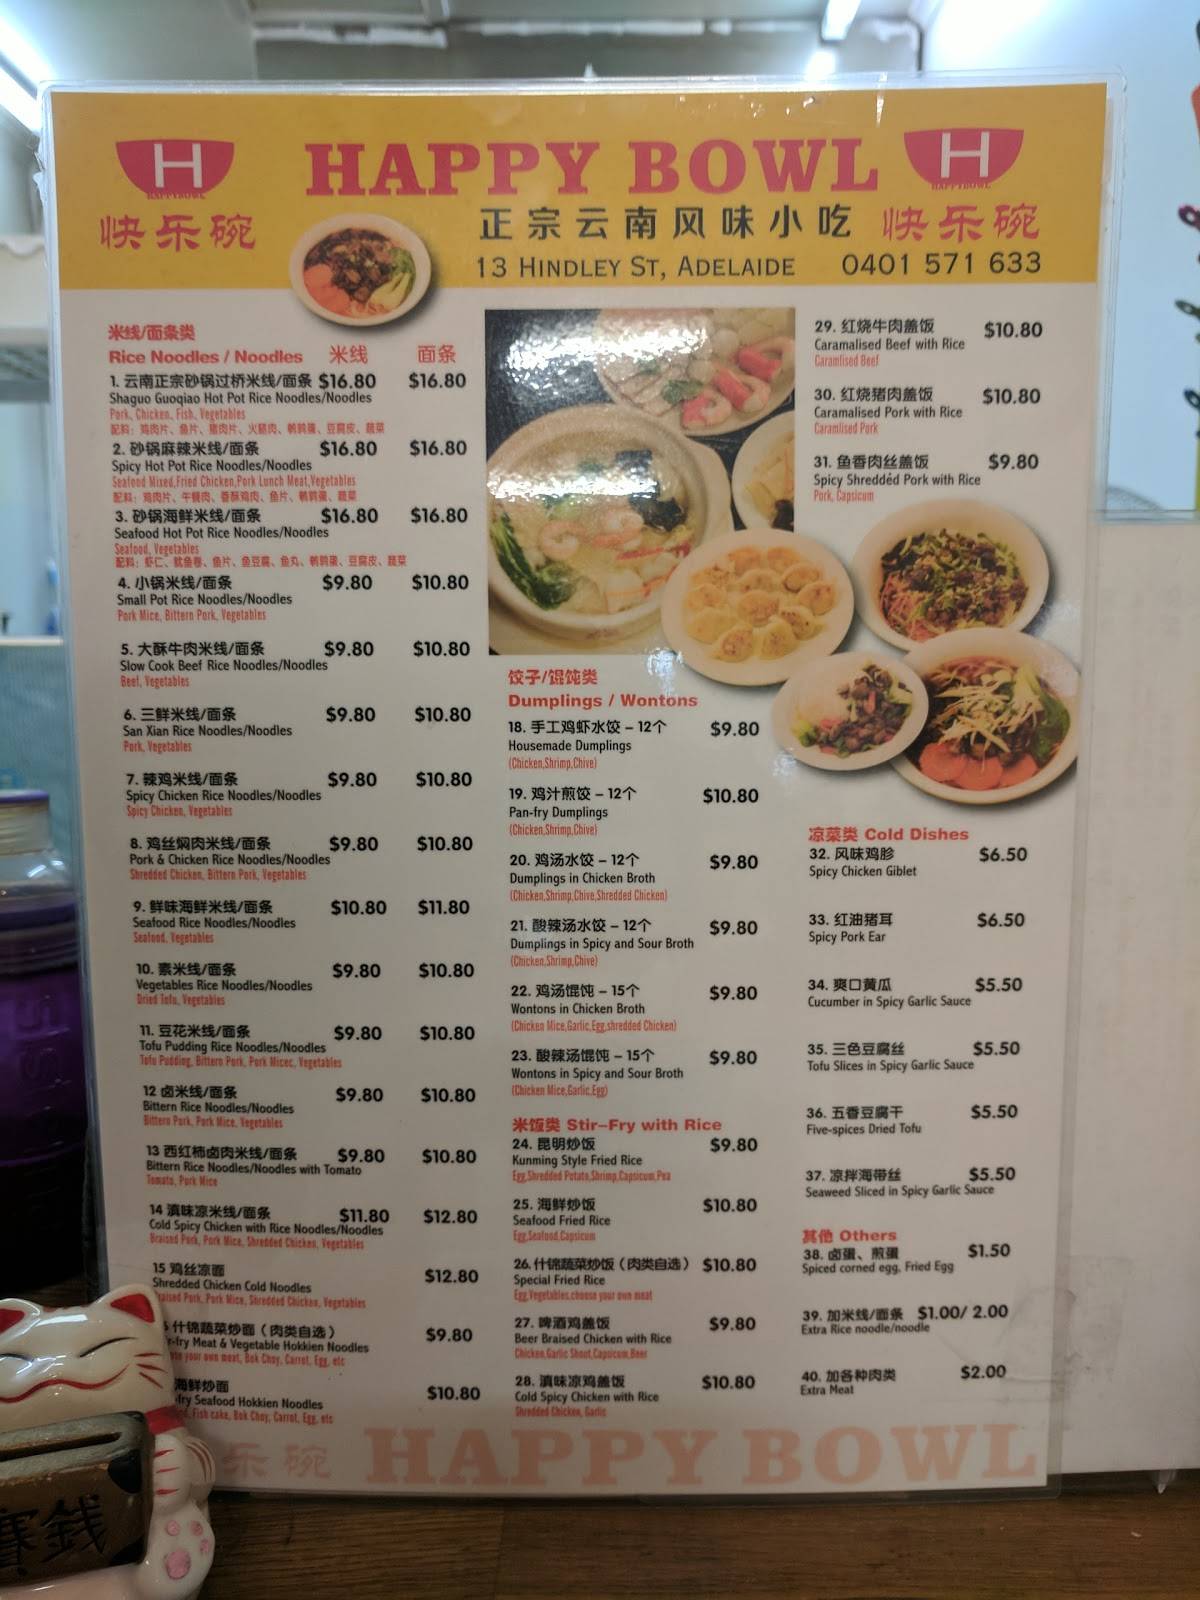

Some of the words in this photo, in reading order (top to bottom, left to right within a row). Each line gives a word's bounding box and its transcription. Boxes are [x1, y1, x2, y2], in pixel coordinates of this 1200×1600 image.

[305, 140, 599, 196] HAPPY
[628, 138, 880, 193] BOWL
[480, 205, 852, 240] 正宗云南风味小吃
[882, 203, 1040, 243] 快乐碗
[100, 214, 256, 252] 快乐碗
[477, 257, 507, 278] 13
[842, 253, 909, 276] 0401
[926, 252, 973, 275] 571
[989, 251, 1041, 274] 633
[108, 324, 195, 341] 米线/面条类
[815, 320, 835, 332] 29.
[841, 318, 934, 334] 红烧牛肉盖饭
[985, 321, 1042, 339] $10.80
[815, 338, 881, 350] Caramalised
[886, 338, 911, 350] Beef
[915, 338, 938, 350] with
[942, 337, 965, 350] Rice
[109, 350, 145, 364] Rice
[151, 350, 220, 364] Noodles
[235, 350, 303, 363] Noodles
[330, 344, 368, 364] 米线
[418, 344, 456, 363] 面条
[815, 355, 858, 367] Caramlised
[860, 355, 880, 367] Beef
[110, 375, 119, 387] 1.
[124, 373, 312, 389] 云南正宗砂锅过桥米线/面条
[319, 373, 376, 390] $16.80
[409, 372, 466, 389] $16.80
[109, 392, 151, 408] Shaguo
[155, 392, 200, 407] Guoqiao
[204, 392, 223, 403] Hot
[227, 392, 245, 404] Pot
[249, 392, 271, 403] Rice
[276, 391, 372, 404] Noodles/Noodles
[118, 577, 130, 589] 4.
[135, 575, 232, 590] 小锅米线/面条
[323, 574, 372, 591] $9.80
[412, 574, 469, 591] $10.80
[117, 594, 146, 605] Small
[150, 593, 168, 605] Pot
[172, 593, 194, 605] Rice
[198, 593, 292, 605] Noodles/Noodles
[508, 669, 597, 685] 饺子/馄饨类
[509, 694, 602, 710] Dumplings
[620, 694, 697, 707] Wontons
[508, 721, 526, 733] 18.
[531, 720, 620, 734] 手工鸡虾水饺
[638, 720, 666, 734] 12个
[711, 721, 759, 737] $9.80
[509, 740, 571, 751] Housemade
[576, 740, 631, 754] Dumplings
[509, 757, 597, 771] (Chicken,Shrimp,Chive)
[126, 773, 138, 785] 7.
[143, 772, 238, 786] 辣鸡米线/面条
[328, 772, 377, 788] $9.80
[416, 772, 472, 787] $10.80
[126, 789, 155, 805] Spicy
[158, 789, 198, 801] Chicken
[202, 789, 224, 801] Rice
[228, 789, 321, 801] Noodles/Noodles
[126, 805, 148, 818] Spicy
[150, 805, 185, 817] Chicken,
[188, 805, 232, 819] Vegetables
[808, 826, 858, 843] 凉菜类
[865, 828, 903, 840] Cold
[910, 827, 969, 840] Dishes
[133, 901, 145, 912] 9.
[149, 900, 272, 914] 鲜味海鲜米线/面条
[331, 900, 387, 916] $10.80
[418, 899, 470, 915] $11.80
[133, 916, 175, 928] Seafood
[179, 917, 200, 928] Rice
[204, 917, 296, 928] Noodles/Noodles
[809, 914, 829, 925] 33.
[834, 913, 893, 926] 红油猪耳
[978, 912, 1025, 928] $6.50
[809, 931, 837, 945] Spicy
[841, 931, 865, 942] Pork
[869, 931, 886, 942] Ear
[806, 1108, 826, 1119] 36.
[832, 1106, 903, 1119] 五香豆腐干
[971, 1104, 1018, 1119] $5.50
[512, 1117, 560, 1133] 米饭类
[641, 1119, 678, 1131] with
[685, 1119, 721, 1130] Rice
[807, 1124, 865, 1137] Five-spices
[869, 1123, 895, 1134] Dried
[899, 1123, 922, 1134] Tofu
[513, 1138, 532, 1149] 24.
[538, 1137, 595, 1151] 昆明炒饭
[711, 1138, 758, 1153] $9.80
[146, 1145, 160, 1158] 13
[164, 1145, 297, 1162] 西红柿卤肉米线/面条
[338, 1148, 385, 1163] $9.80
[422, 1149, 476, 1164] $10.80
[146, 1160, 180, 1171] Bittern
[183, 1161, 204, 1172] Rice
[208, 1161, 296, 1174] Noodles/Noodles
[299, 1164, 320, 1174] with
[324, 1164, 362, 1175] Tomato
[513, 1155, 558, 1169] Kunming
[561, 1154, 587, 1168] Style
[591, 1154, 617, 1166] Fried
[621, 1154, 642, 1165] Rice
[513, 1199, 533, 1210] 25.
[538, 1198, 595, 1211] 海鲜炒饭
[703, 1198, 757, 1213] $10.80
[513, 1215, 555, 1226] Seafood
[559, 1215, 585, 1226] Fried
[589, 1215, 610, 1226] Rice
[802, 1229, 833, 1243] 其他
[840, 1230, 897, 1241] Others
[804, 1249, 824, 1260] 38.
[828, 1247, 899, 1260] 卤蛋、煎蛋
[968, 1243, 1010, 1258] $1.50
[802, 1263, 836, 1276] Spiced
[840, 1262, 875, 1273] corned
[879, 1264, 901, 1275] egg,
[905, 1261, 931, 1272] Fried
[934, 1261, 954, 1274] Egg
[802, 1371, 821, 1381] 40.
[826, 1368, 896, 1382] 加各种肉类
[961, 1365, 1006, 1380] $2.00
[800, 1384, 826, 1396] Extra
[830, 1384, 854, 1395] Meat
[223, 1443, 331, 1480] 乐碗
[365, 1427, 718, 1487] HAPPY
[742, 1424, 1037, 1487] BOWL
